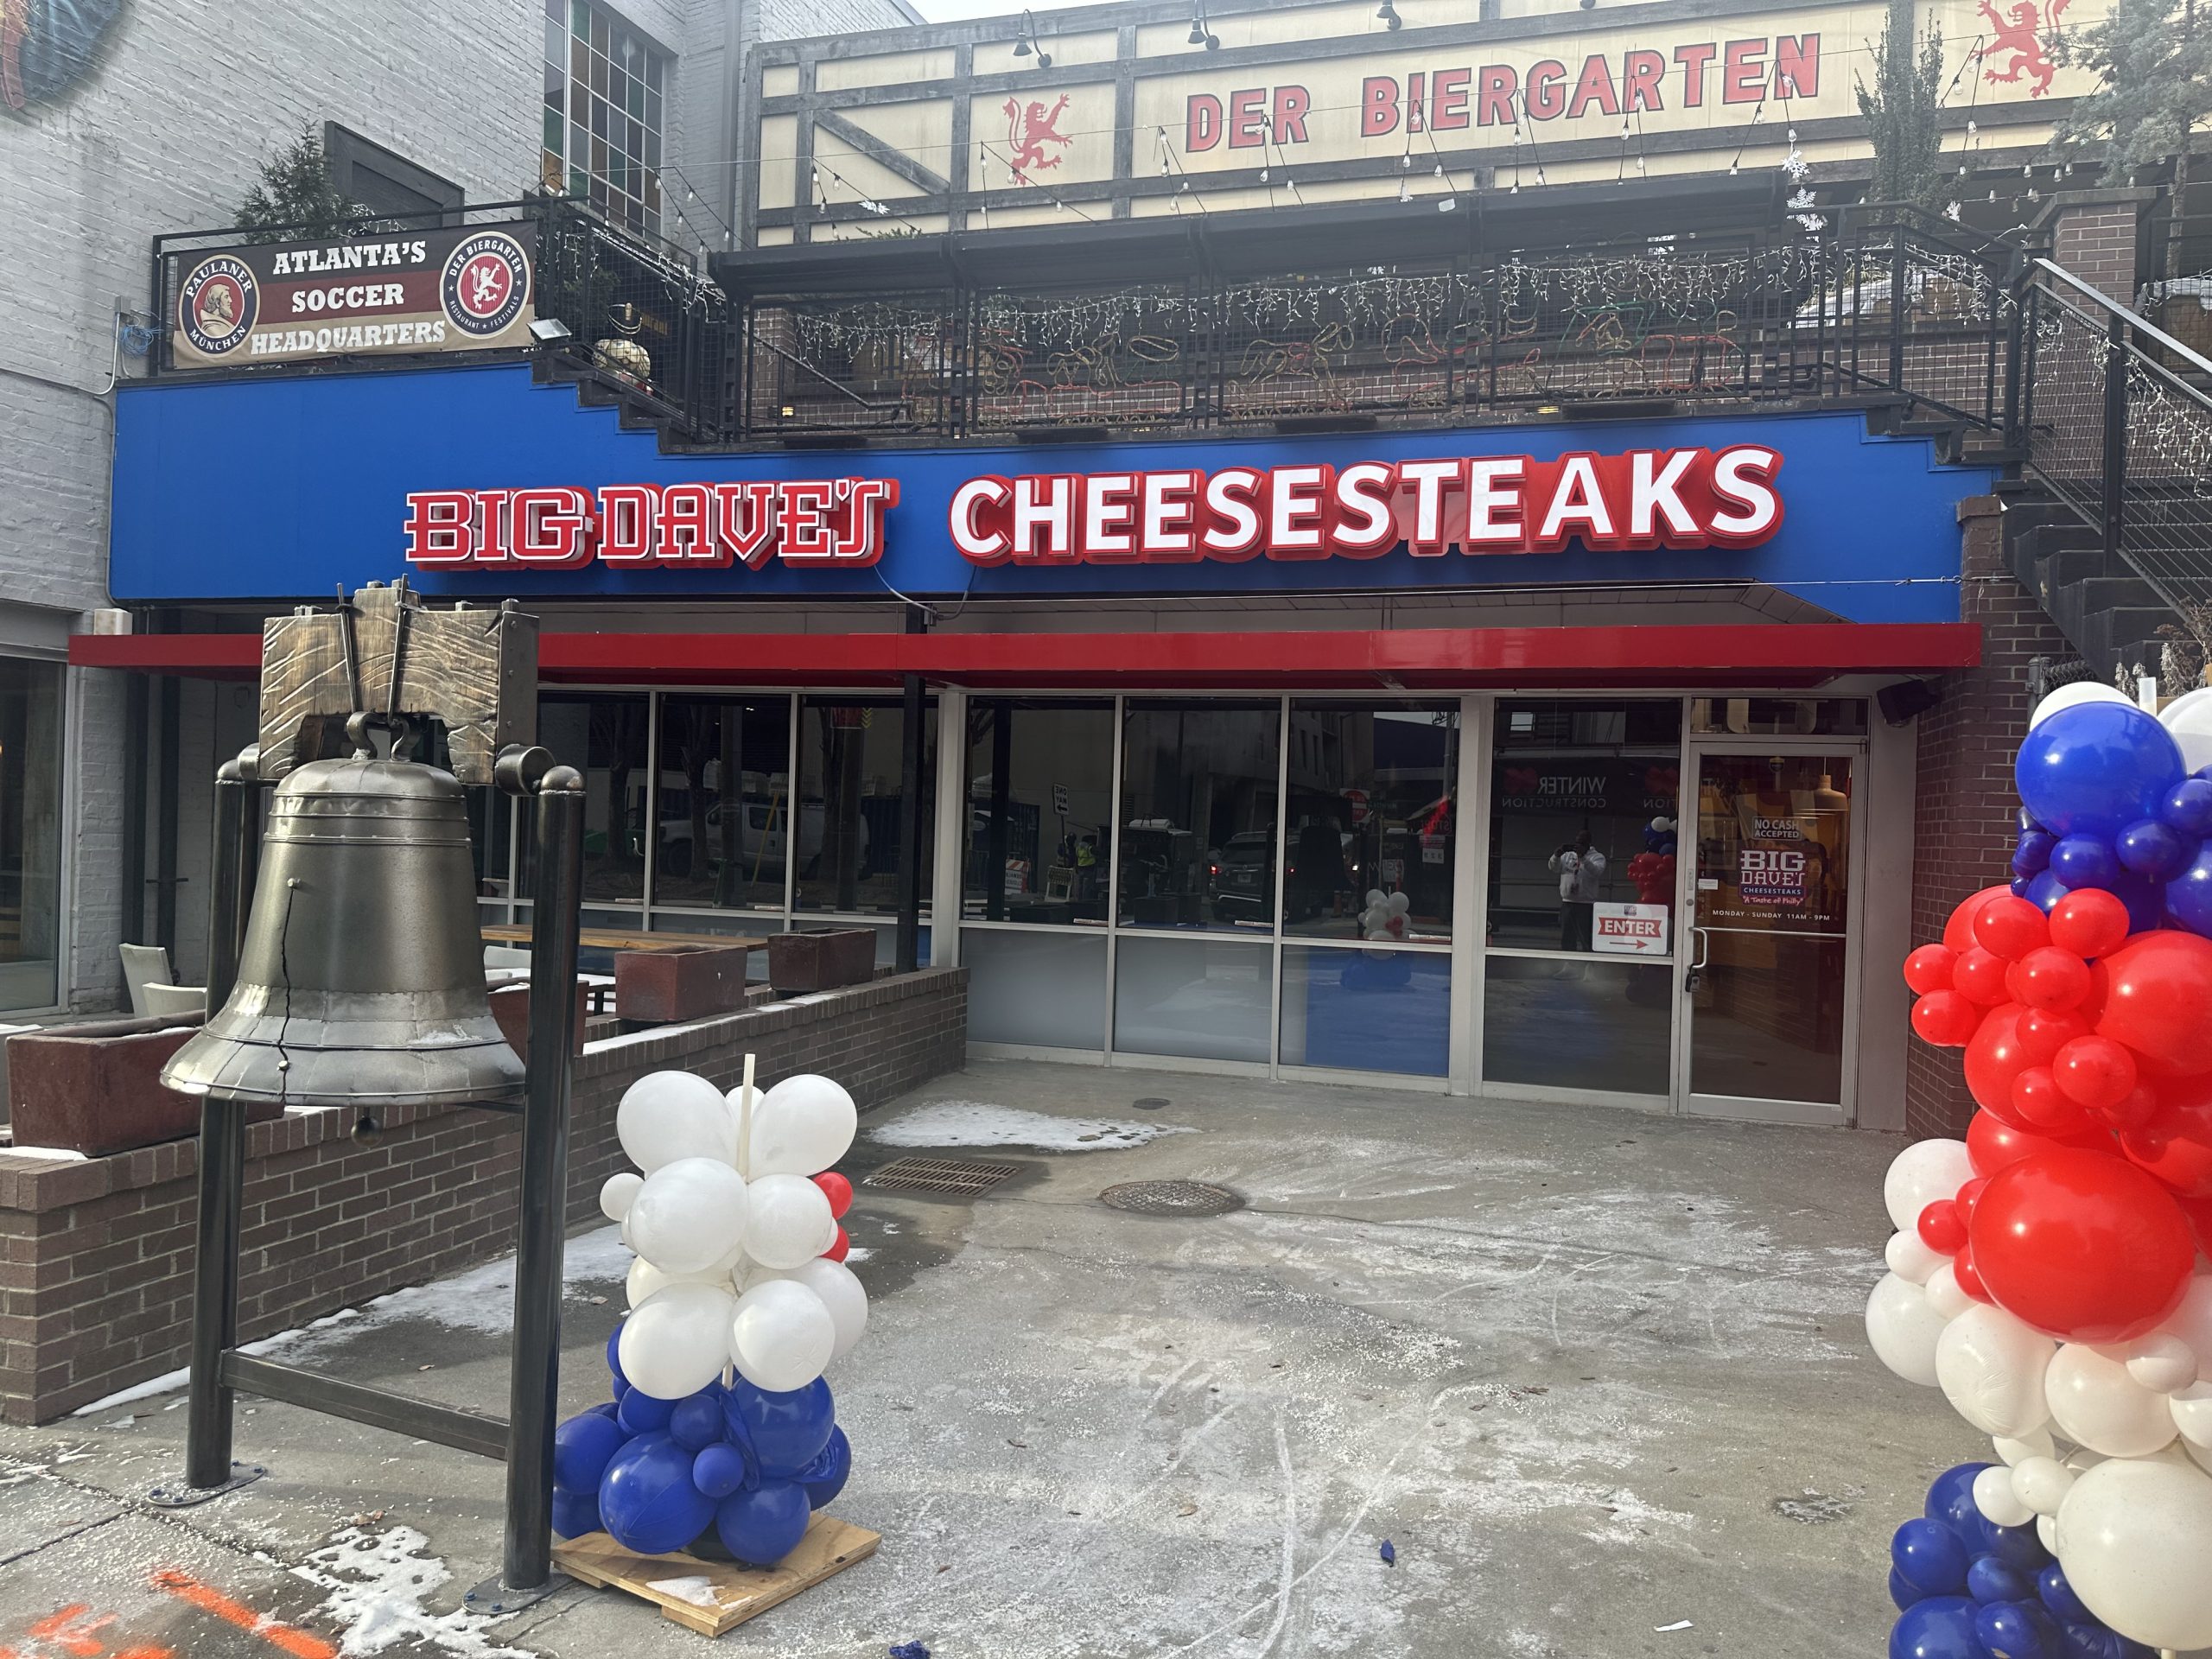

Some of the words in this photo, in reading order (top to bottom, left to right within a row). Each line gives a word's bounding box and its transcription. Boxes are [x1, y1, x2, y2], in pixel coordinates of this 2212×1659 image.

[1185, 85, 1311, 153] DER
[1361, 33, 1821, 137] BIERGARTEN
[272, 241, 426, 275] ATLANTA'S
[449, 254, 466, 276] DER
[467, 240, 522, 273] BIERGARTEN
[186, 261, 252, 297] PAULANER
[292, 283, 404, 313] SOCCER
[449, 300, 480, 328] RESTAURANT
[490, 296, 519, 327] FESTIVALS
[190, 326, 246, 350] MÜNCHEN
[251, 321, 446, 355] HEADQUARTERS
[949, 443, 1783, 560] CHEESESTEAKS
[404, 486, 594, 566] BIG
[597, 478, 893, 564] DAVE'S
[1754, 819, 1770, 830] NO
[1772, 819, 1799, 830] CASH
[1740, 849, 1806, 871] BIG
[1740, 870, 1805, 886] DAVE'S
[1604, 919, 1656, 935] ENTER
